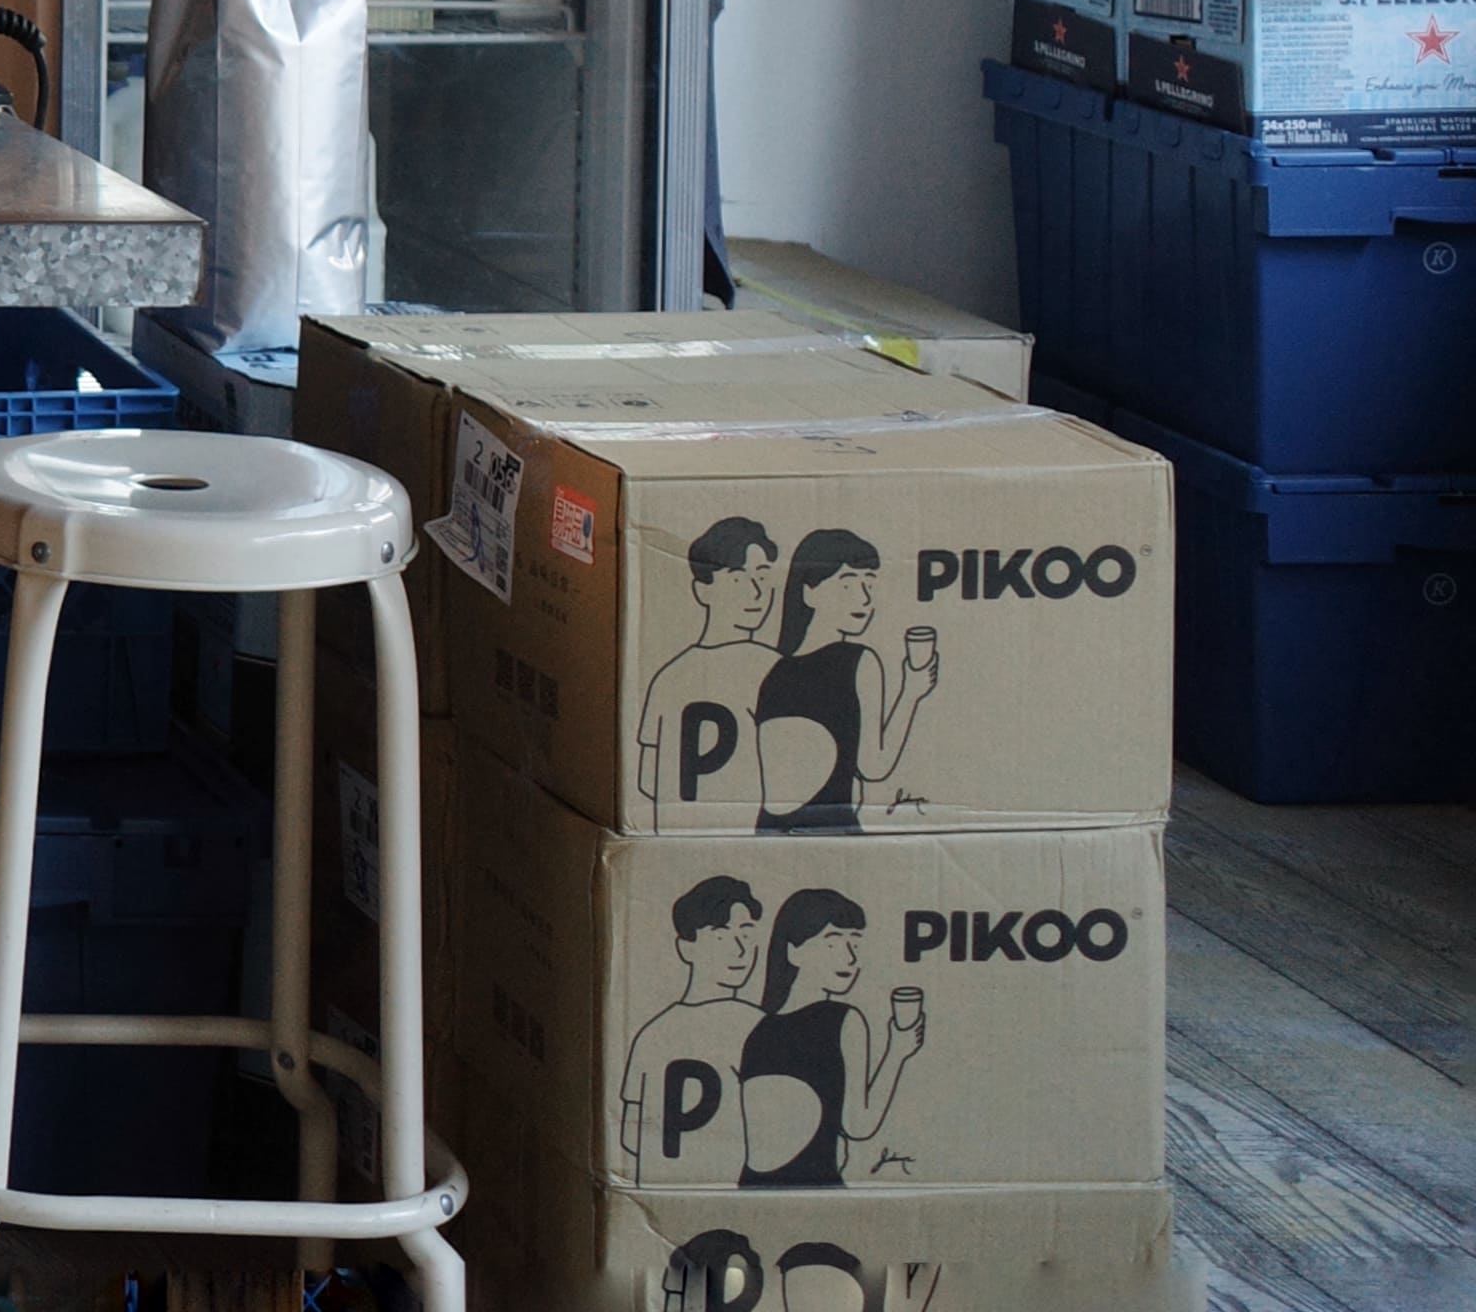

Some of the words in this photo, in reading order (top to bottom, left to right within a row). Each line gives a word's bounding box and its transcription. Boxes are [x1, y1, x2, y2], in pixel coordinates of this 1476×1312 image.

[917, 544, 1137, 602] PIKOO
[680, 701, 738, 802] P
[903, 908, 1129, 963] PIKOO
[662, 1058, 723, 1159] P
